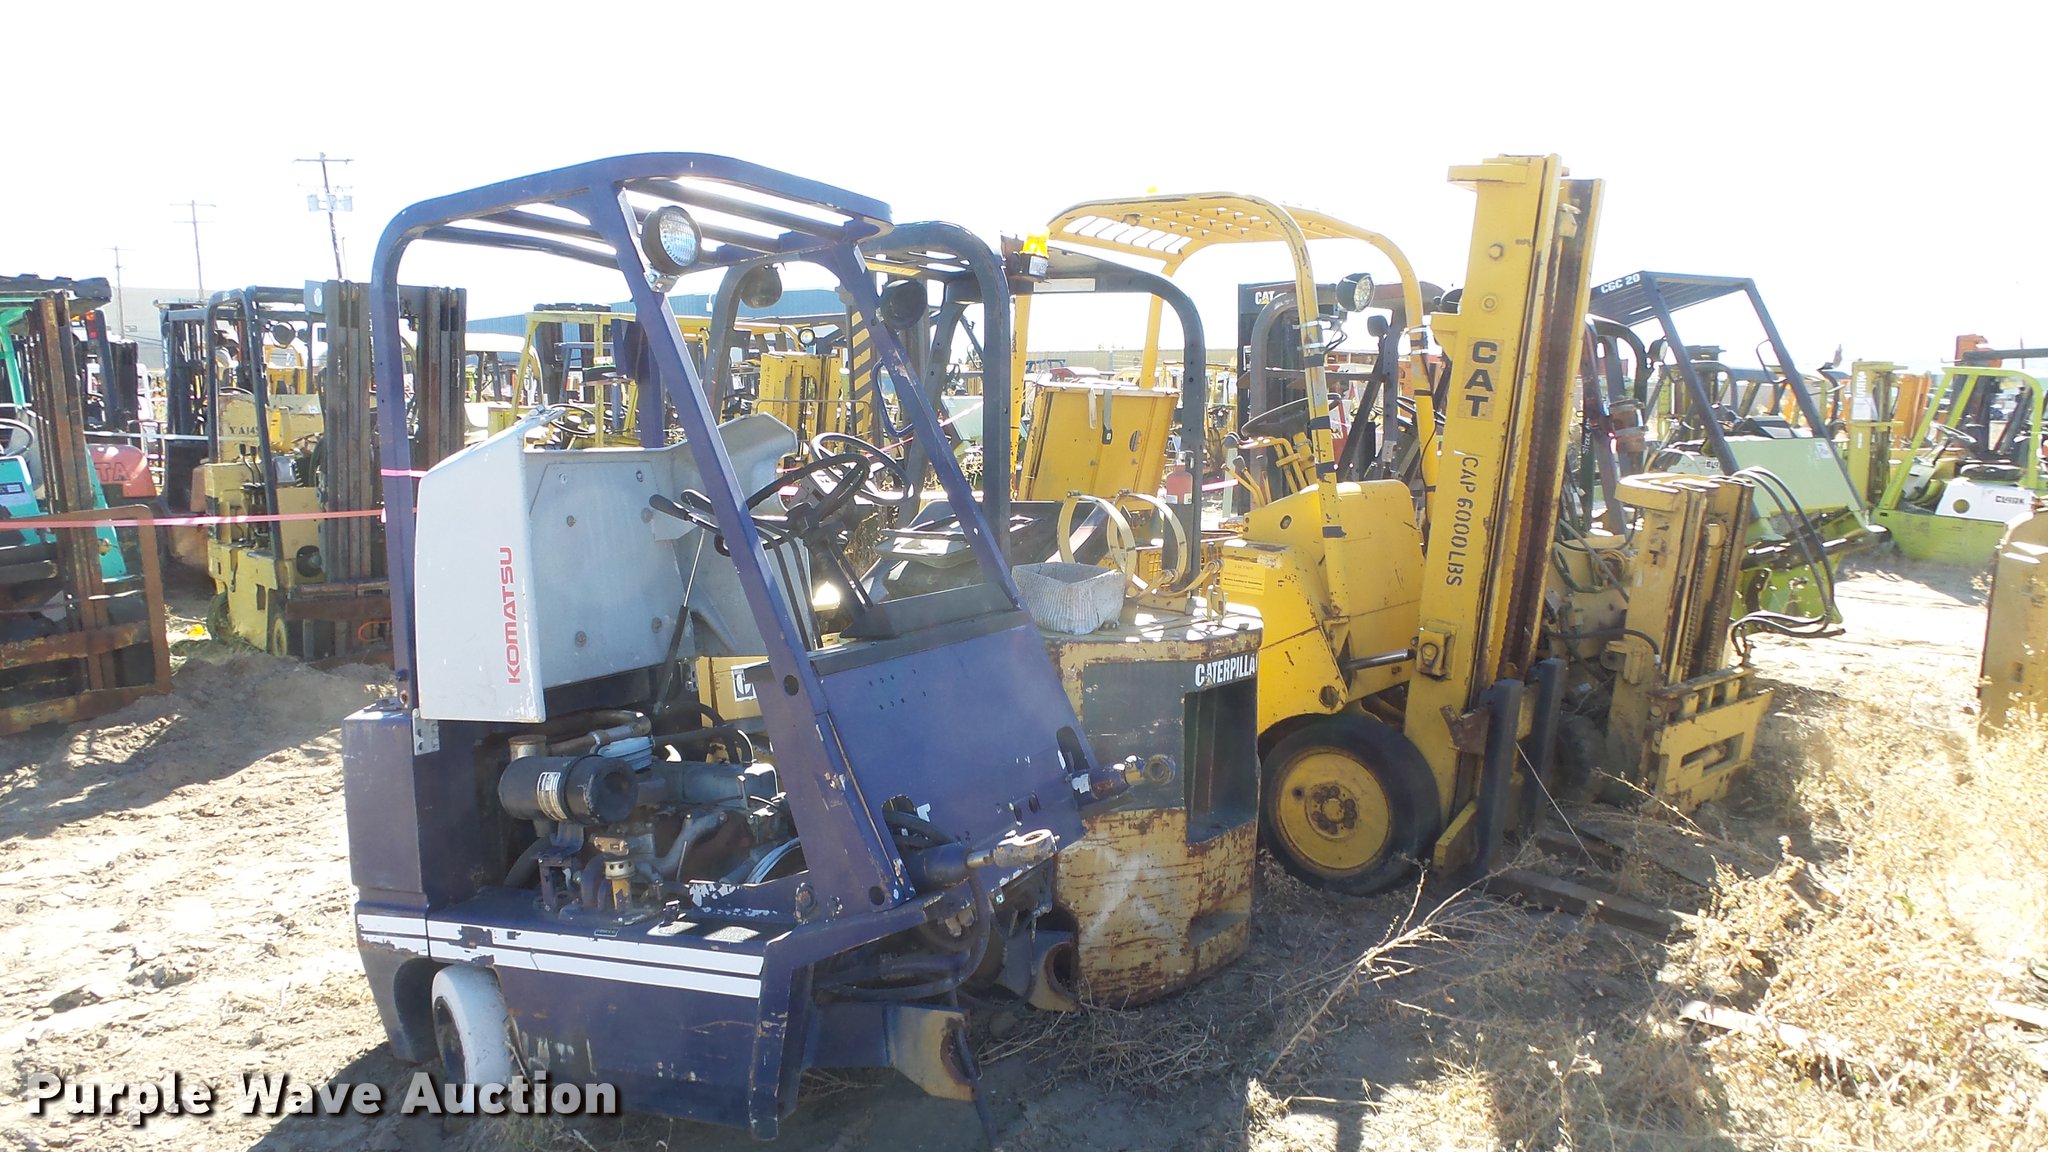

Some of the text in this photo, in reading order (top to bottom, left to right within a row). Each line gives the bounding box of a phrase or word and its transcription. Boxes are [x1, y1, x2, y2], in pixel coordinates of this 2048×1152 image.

[1255, 291, 1275, 305] CAT
[1600, 273, 1641, 294] CGC 20
[1464, 341, 1498, 417] CAT
[1459, 456, 1479, 493] CAP
[499, 546, 521, 684] KOMATSU
